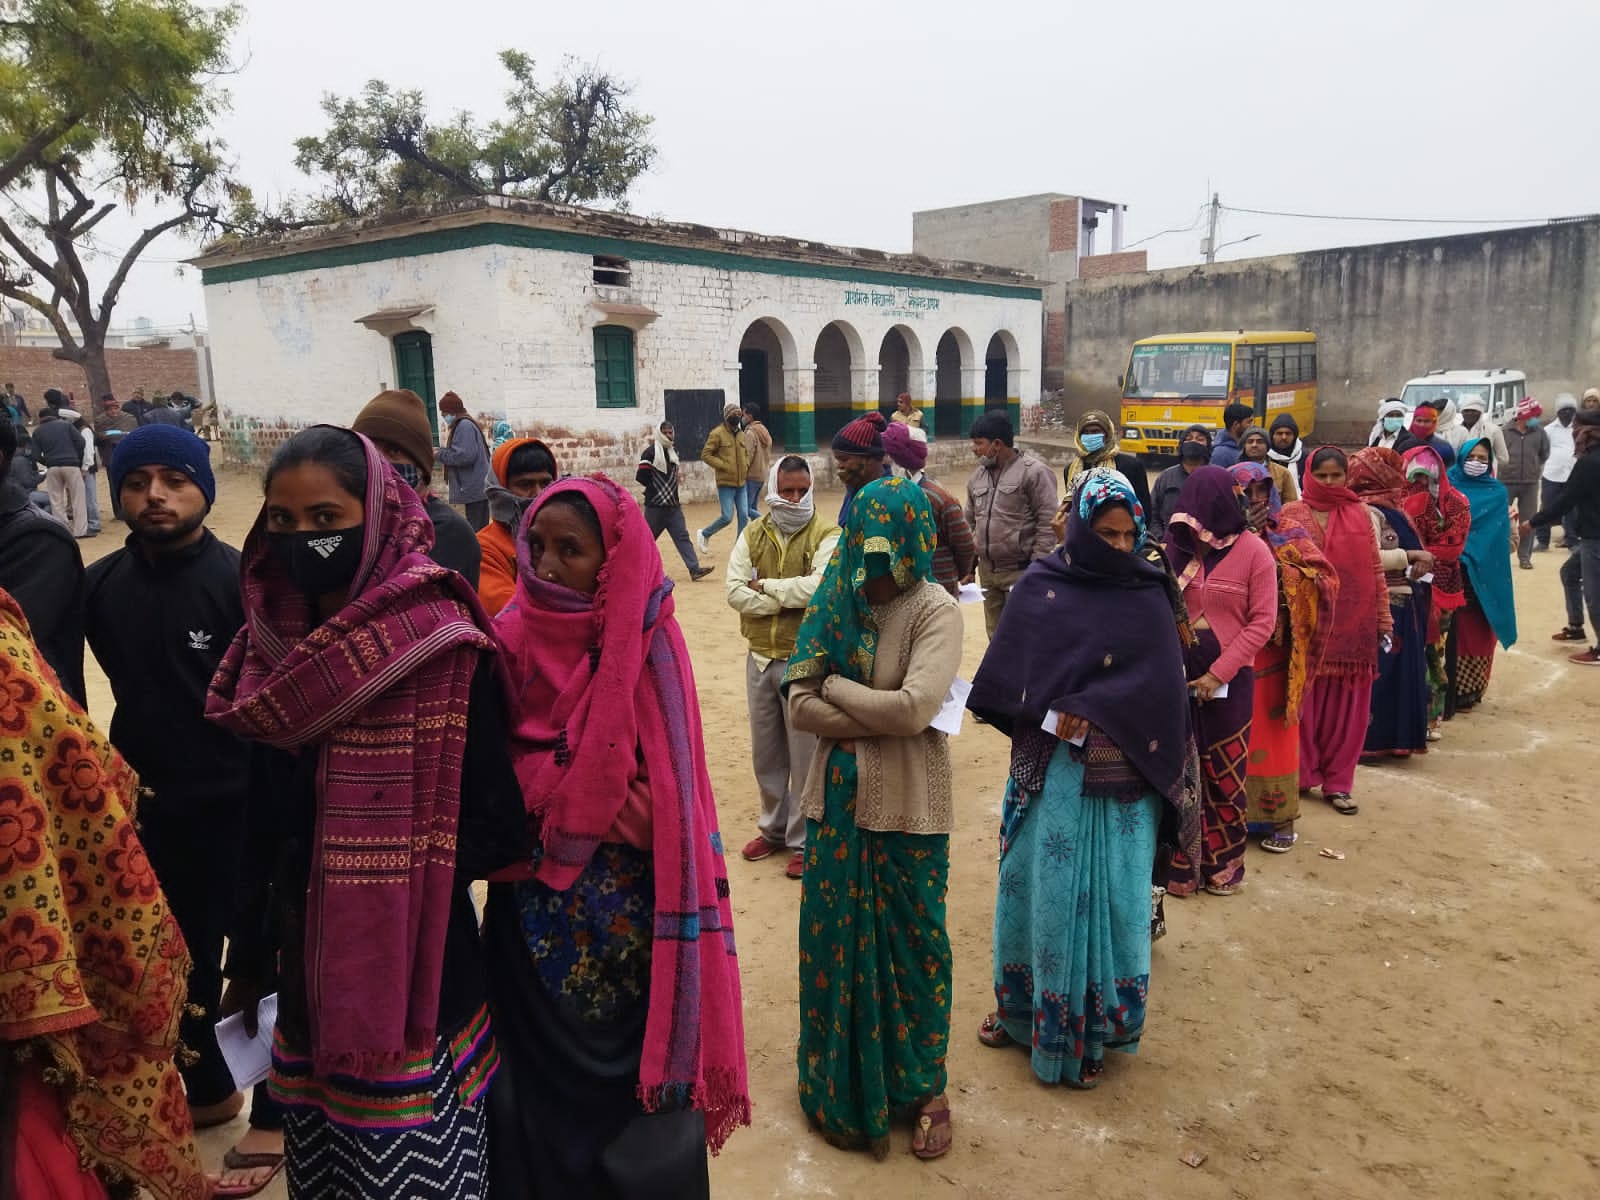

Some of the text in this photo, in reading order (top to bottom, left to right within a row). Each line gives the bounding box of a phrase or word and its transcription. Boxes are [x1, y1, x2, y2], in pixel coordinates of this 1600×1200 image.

[844, 288, 870, 305] प्राथमिक
[871, 289, 896, 306] विद्यालय
[307, 535, 343, 548] adidas
